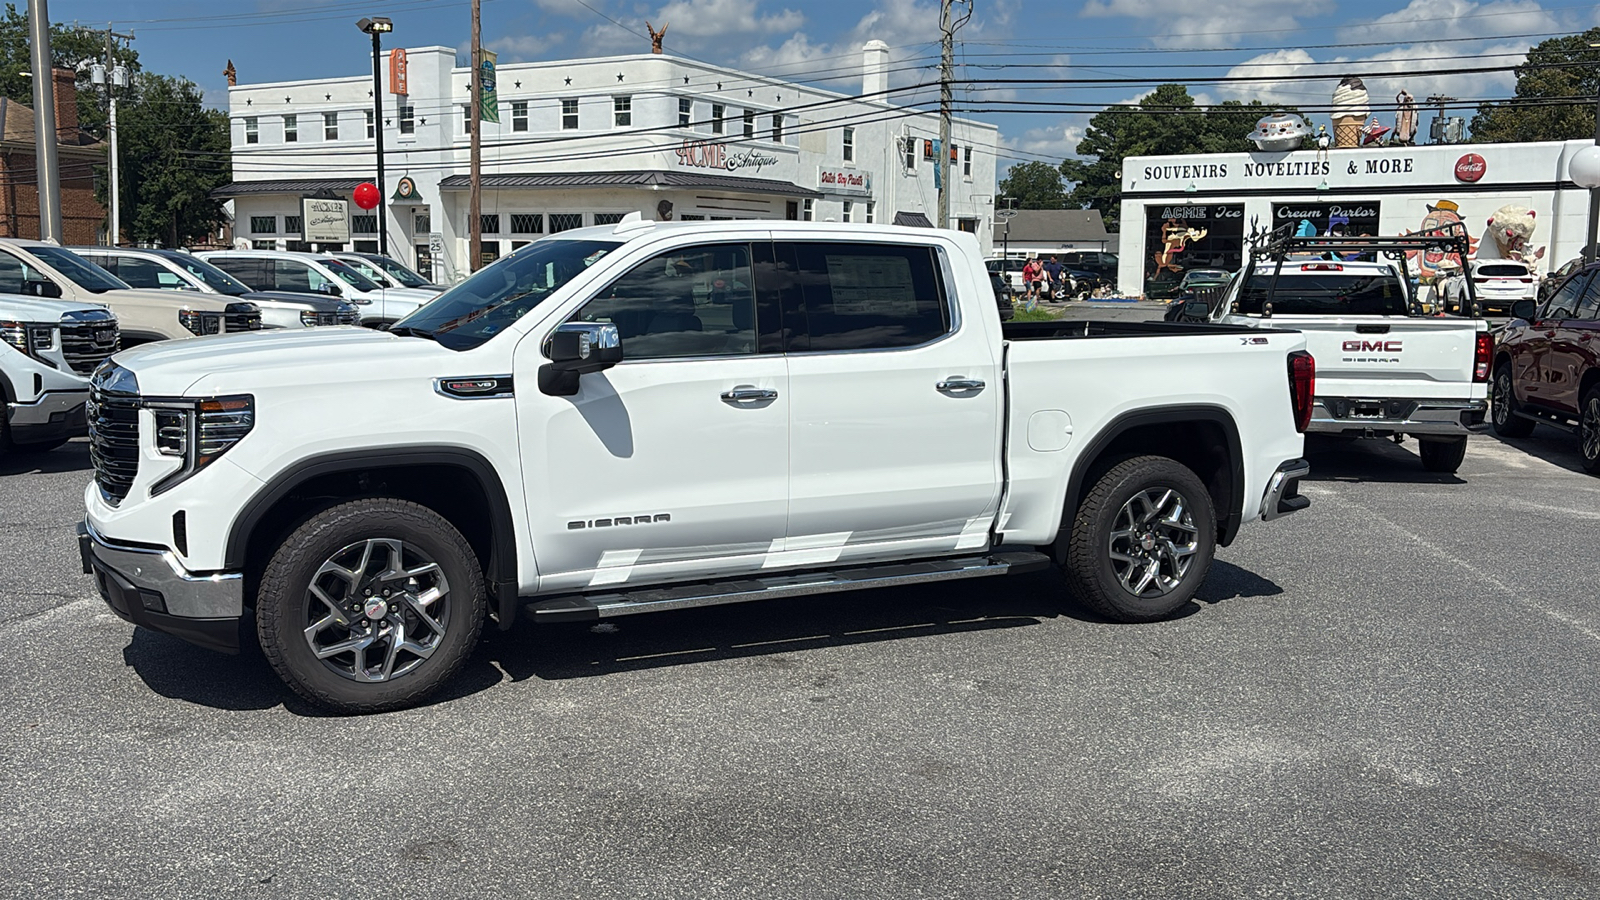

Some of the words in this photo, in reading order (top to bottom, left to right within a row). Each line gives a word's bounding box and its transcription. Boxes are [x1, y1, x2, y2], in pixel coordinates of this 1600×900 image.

[397, 52, 406, 92] ACME
[675, 138, 727, 170] ACME
[726, 147, 779, 173] Antiques
[1144, 164, 1228, 180] SOUVENIRS
[1244, 161, 1330, 177] NOVELTIES
[1347, 160, 1358, 175] &
[1365, 158, 1414, 174] MORE
[821, 171, 836, 184] Dutch
[837, 172, 847, 186] Boy
[847, 173, 864, 187] Paints
[1161, 206, 1207, 219] ACME
[1215, 205, 1243, 218] Ice
[1277, 206, 1322, 219] Cream
[1328, 206, 1377, 219] Parlor
[431, 242, 441, 251] 25
[1342, 340, 1403, 352] GMC
[567, 513, 671, 530] SIERRA
